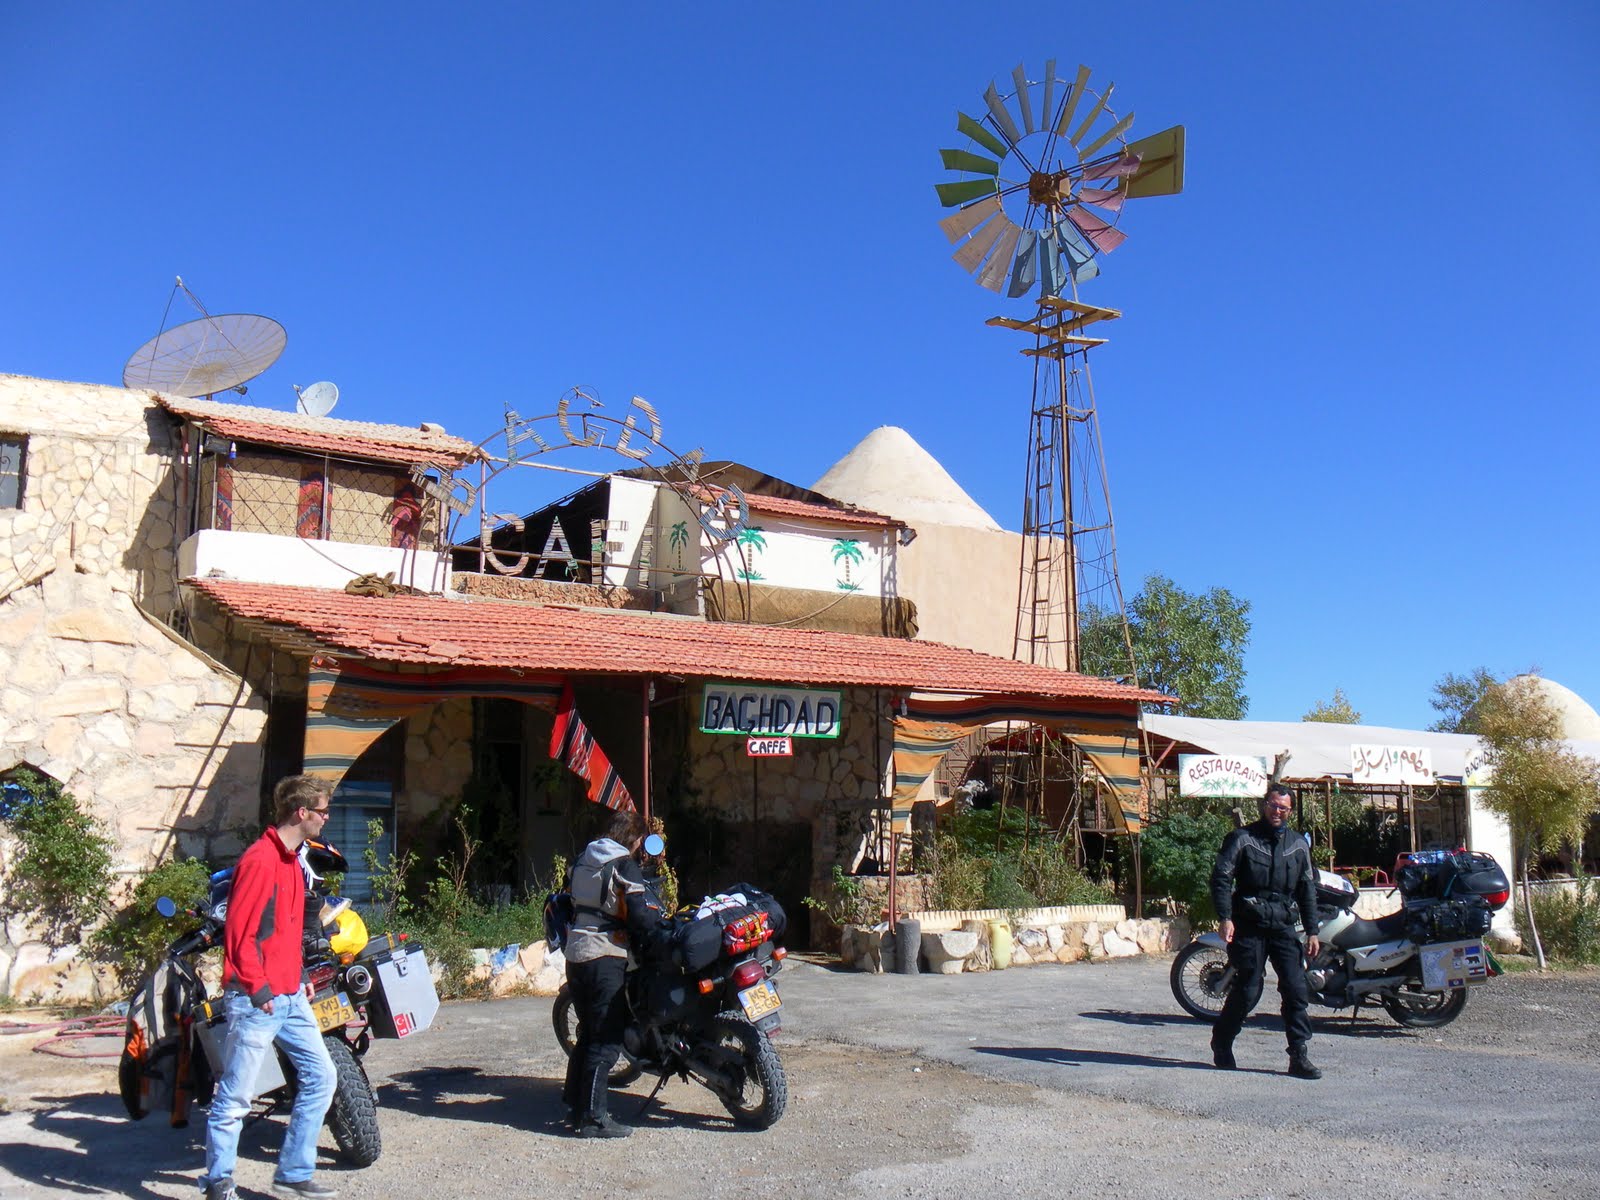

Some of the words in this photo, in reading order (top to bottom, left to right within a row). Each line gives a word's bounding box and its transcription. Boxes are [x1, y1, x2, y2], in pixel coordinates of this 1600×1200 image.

[704, 691, 838, 734] BAGHDAD
[749, 741, 786, 754] CAFFE
[1189, 759, 1266, 786] RESTAURANT
[320, 1008, 351, 1029] B-73
